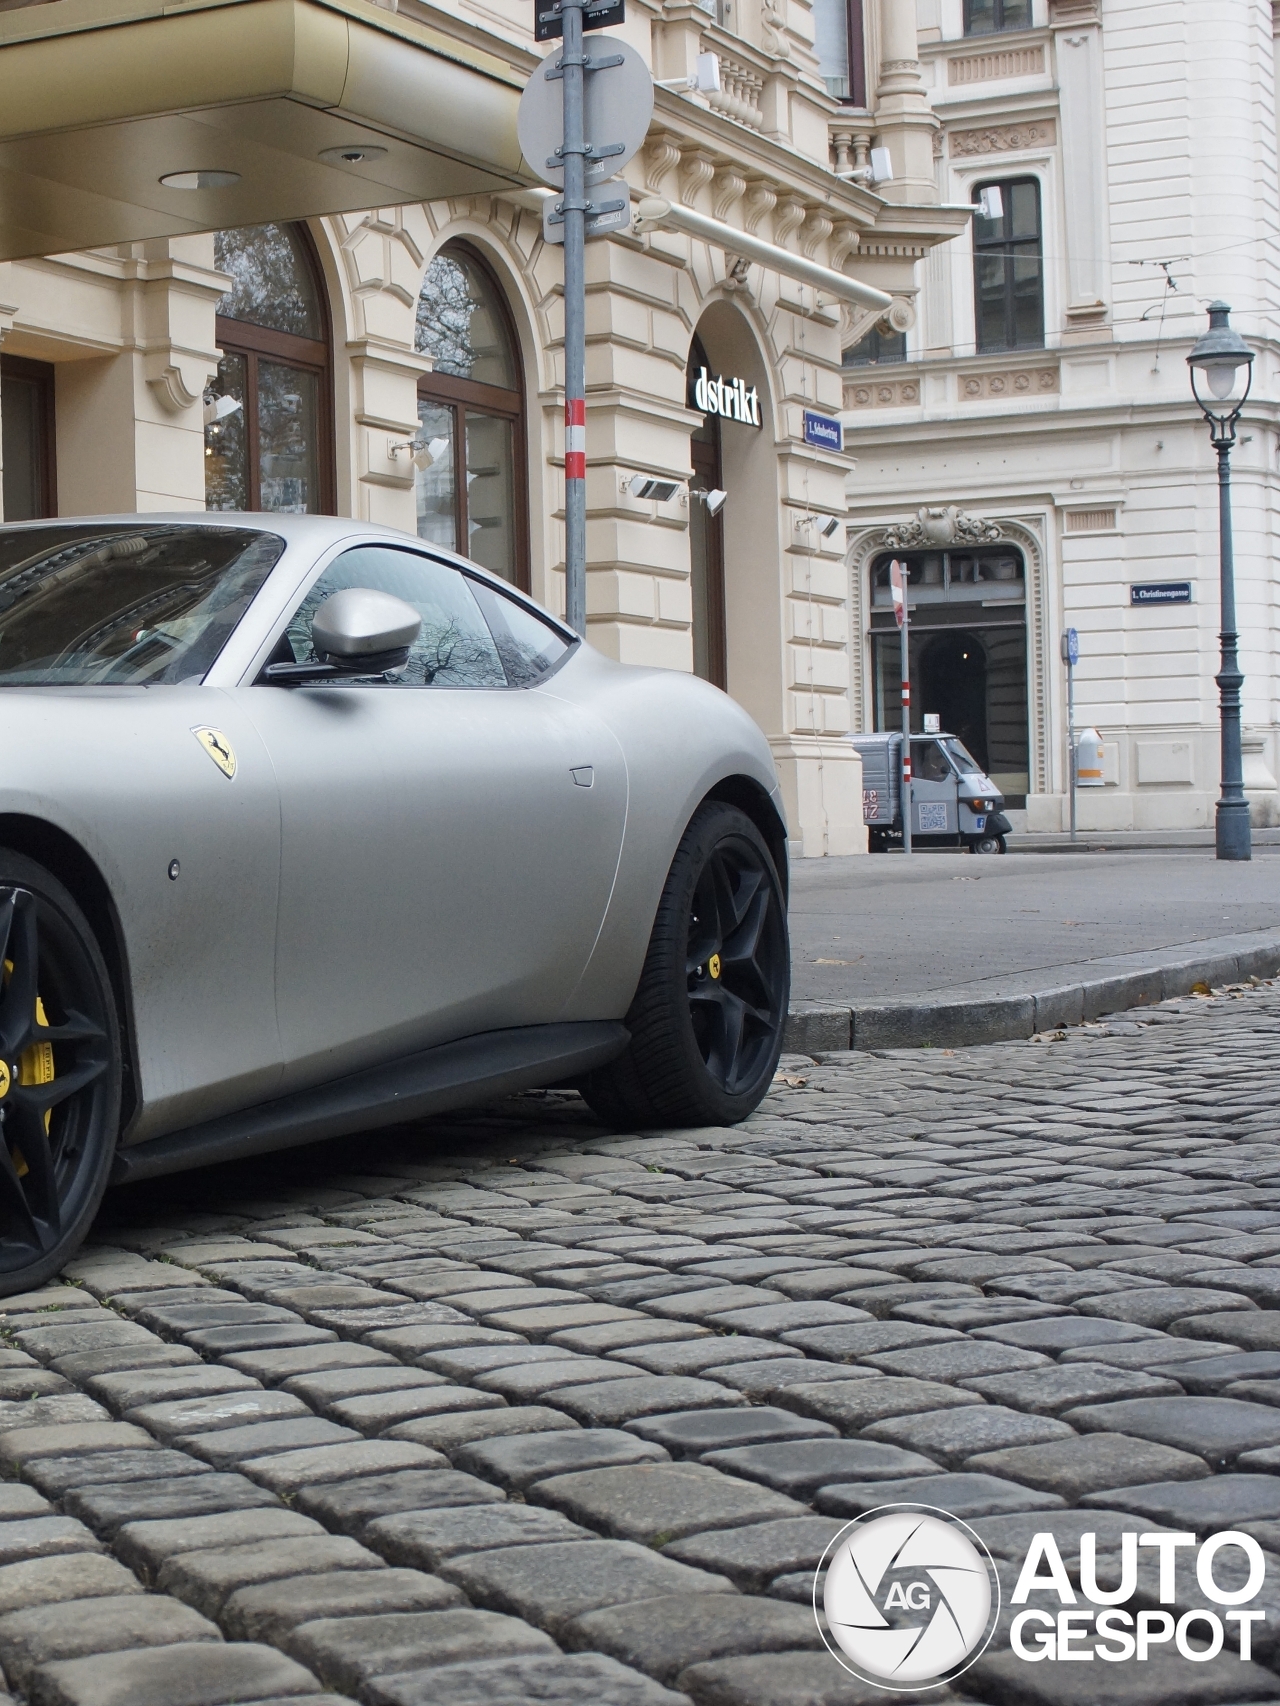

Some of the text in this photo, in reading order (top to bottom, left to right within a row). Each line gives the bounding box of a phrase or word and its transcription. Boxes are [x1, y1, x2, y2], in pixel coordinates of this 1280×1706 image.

[695, 366, 760, 426] dstrikt
[814, 421, 837, 444] Schubertring
[1139, 589, 1189, 599] Christinengasse
